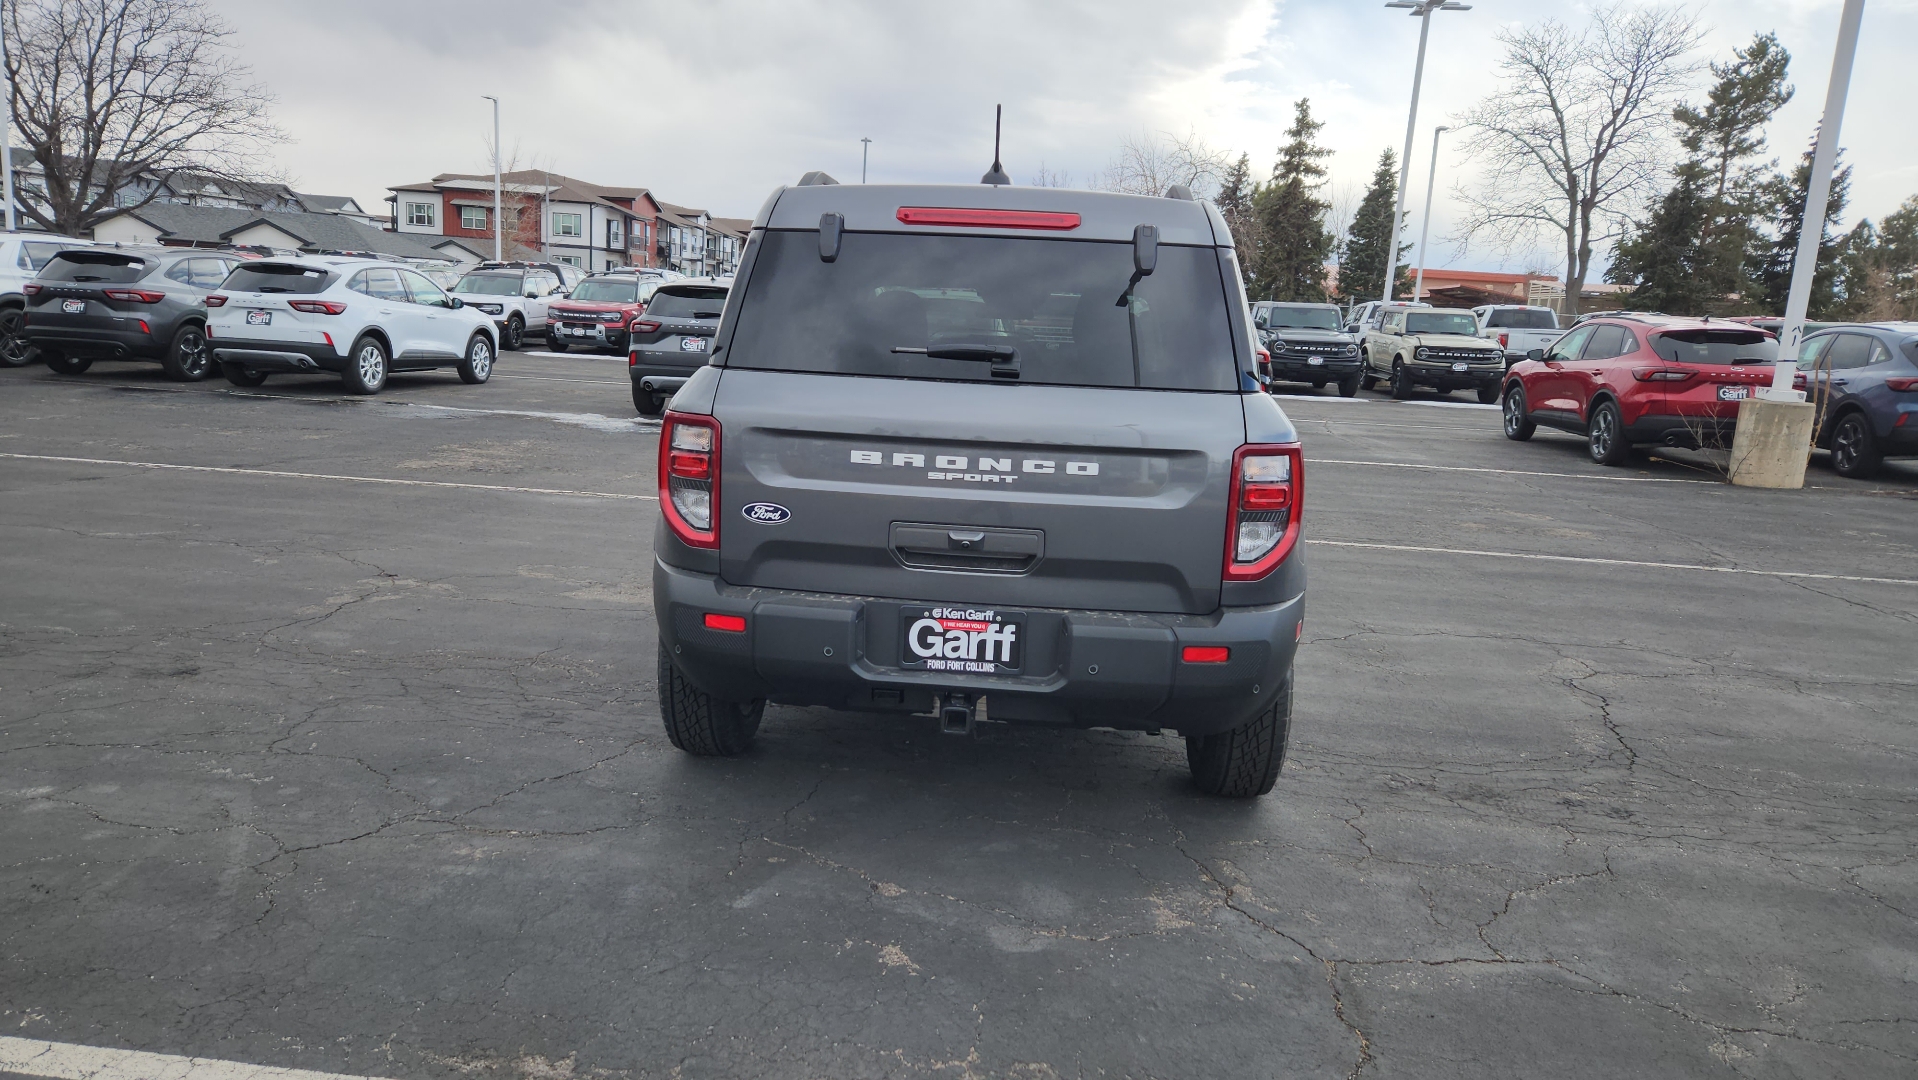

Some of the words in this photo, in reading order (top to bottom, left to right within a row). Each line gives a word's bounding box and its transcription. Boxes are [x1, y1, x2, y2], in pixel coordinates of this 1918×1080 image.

[681, 339, 706, 350] Garff
[1720, 387, 1748, 399] Garff
[850, 449, 1100, 476] BRONCO
[927, 471, 1018, 483] SPORT
[751, 505, 782, 520] Ford
[943, 608, 965, 619] Ken
[966, 609, 995, 621] Garff
[909, 618, 1016, 661] Garff
[927, 659, 946, 670] FORD
[947, 660, 965, 671] FORT
[966, 662, 995, 673] COLLINS
